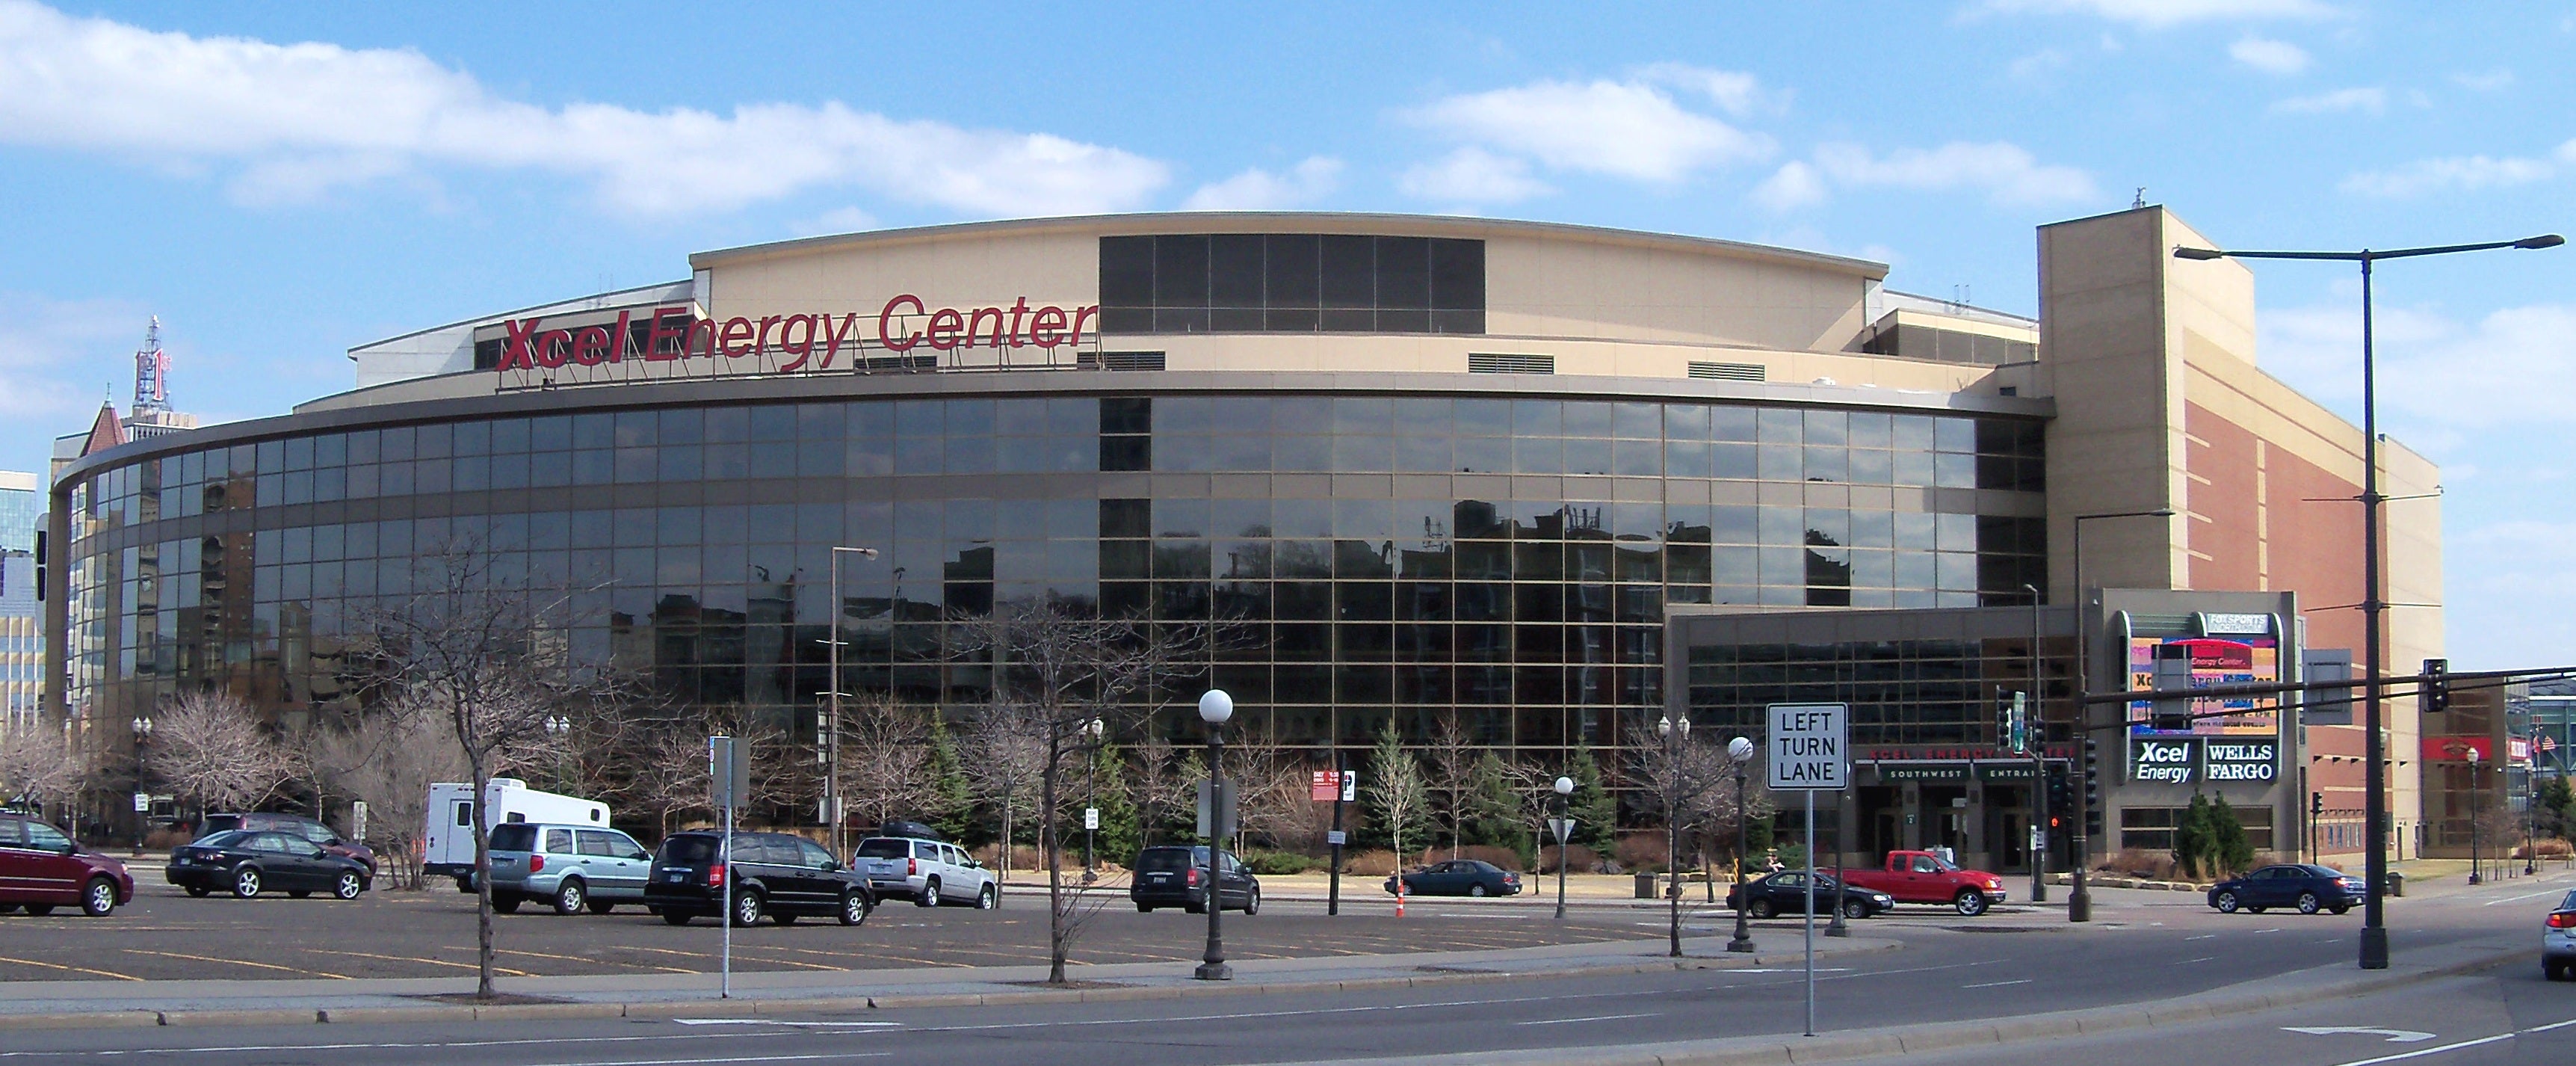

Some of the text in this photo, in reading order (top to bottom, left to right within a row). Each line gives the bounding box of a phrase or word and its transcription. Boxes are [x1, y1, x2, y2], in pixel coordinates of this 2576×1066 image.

[495, 294, 1100, 372] Xcel Energy Center
[1782, 712, 1832, 731] LEFT
[1779, 737, 1835, 757] TURN
[1926, 748, 1995, 760] ENERGY
[2138, 742, 2190, 762] Xcel
[2208, 745, 2273, 761] WELLS
[1780, 762, 1835, 780] LANE
[2137, 763, 2191, 784] Energy
[2208, 763, 2273, 780] FARGO
